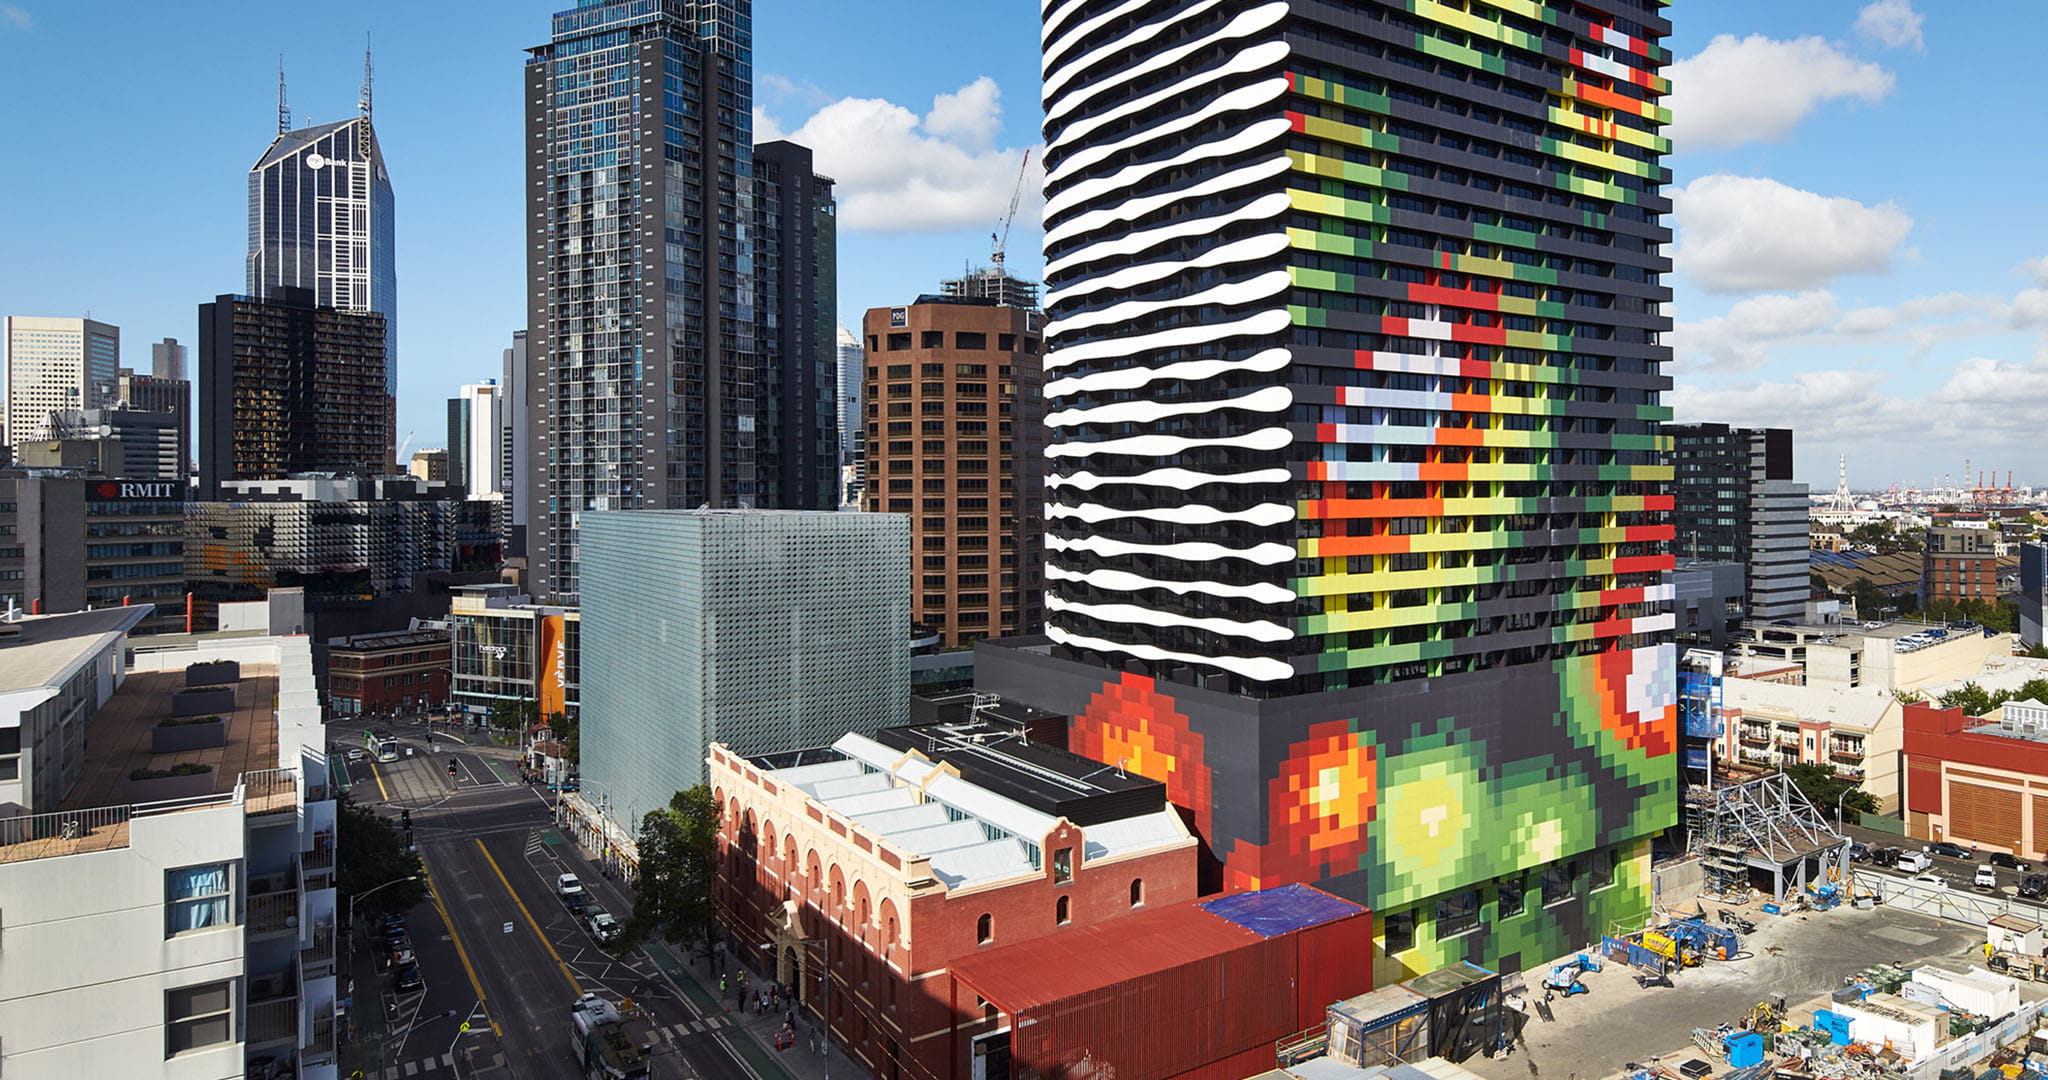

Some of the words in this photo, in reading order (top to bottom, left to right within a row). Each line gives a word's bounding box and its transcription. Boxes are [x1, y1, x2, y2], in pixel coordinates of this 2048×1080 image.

[325, 158, 347, 167] Bank
[892, 312, 904, 320] PDG
[120, 483, 175, 498] RMIT
